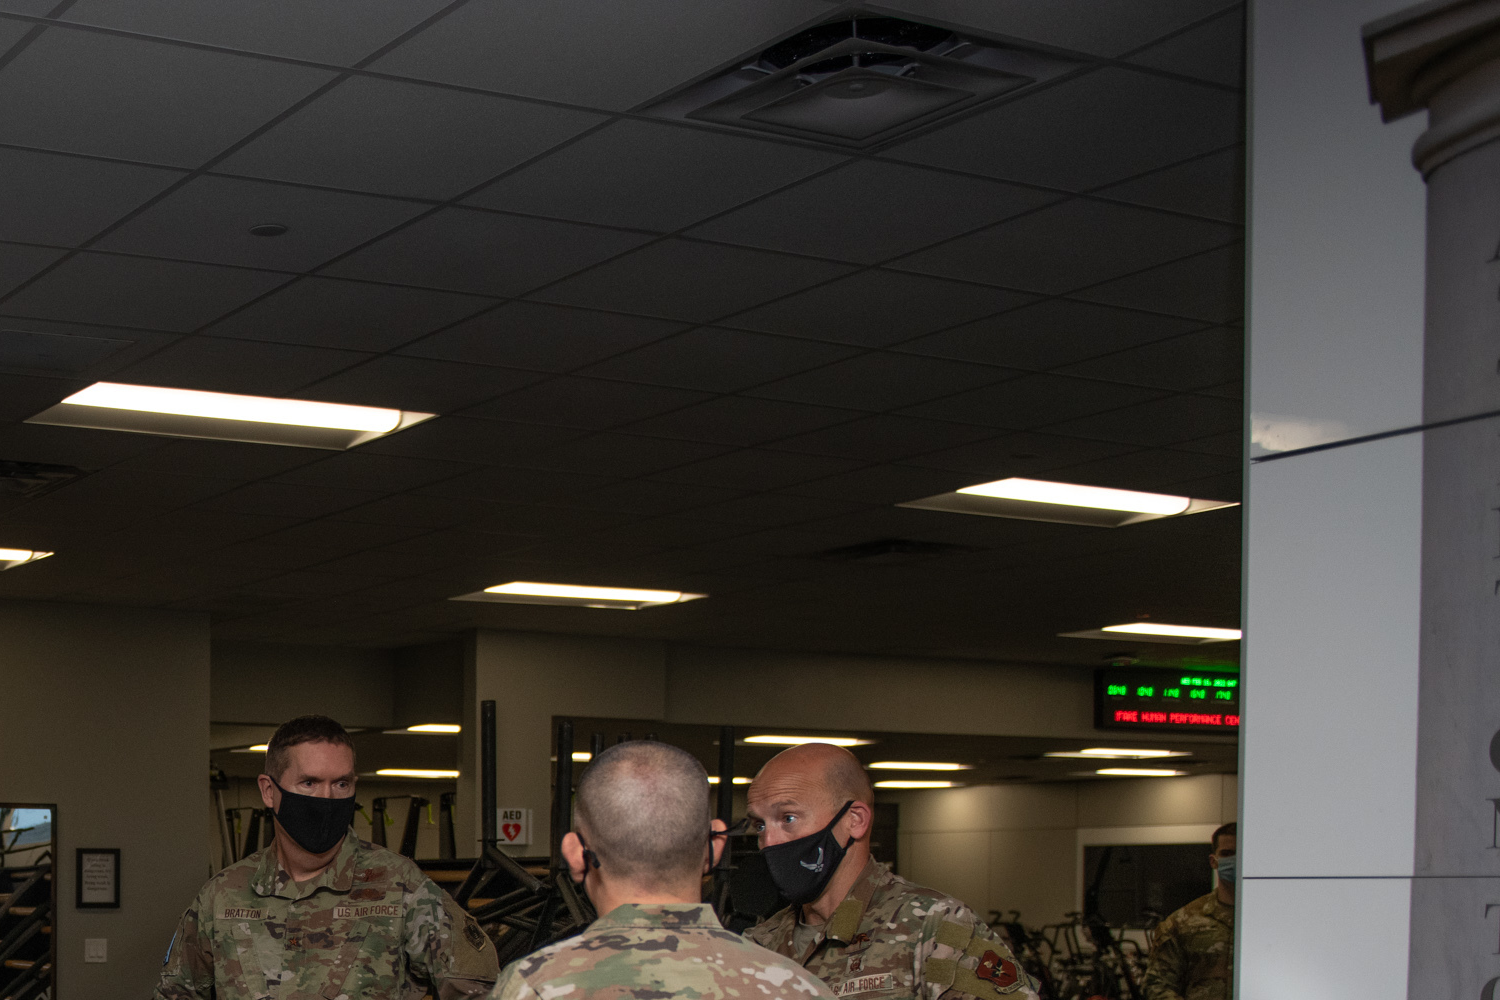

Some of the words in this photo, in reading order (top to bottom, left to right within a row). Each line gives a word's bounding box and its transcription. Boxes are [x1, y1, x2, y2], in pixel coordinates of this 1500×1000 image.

[1141, 711, 1167, 723] HUMAN
[1169, 712, 1222, 725] PERFORMANCE
[503, 810, 522, 820] AED
[224, 908, 262, 919] BRATTON
[354, 907, 368, 917] AIR
[370, 905, 398, 916] FORCE
[843, 981, 855, 994] AIR
[858, 976, 885, 991] FORCE
